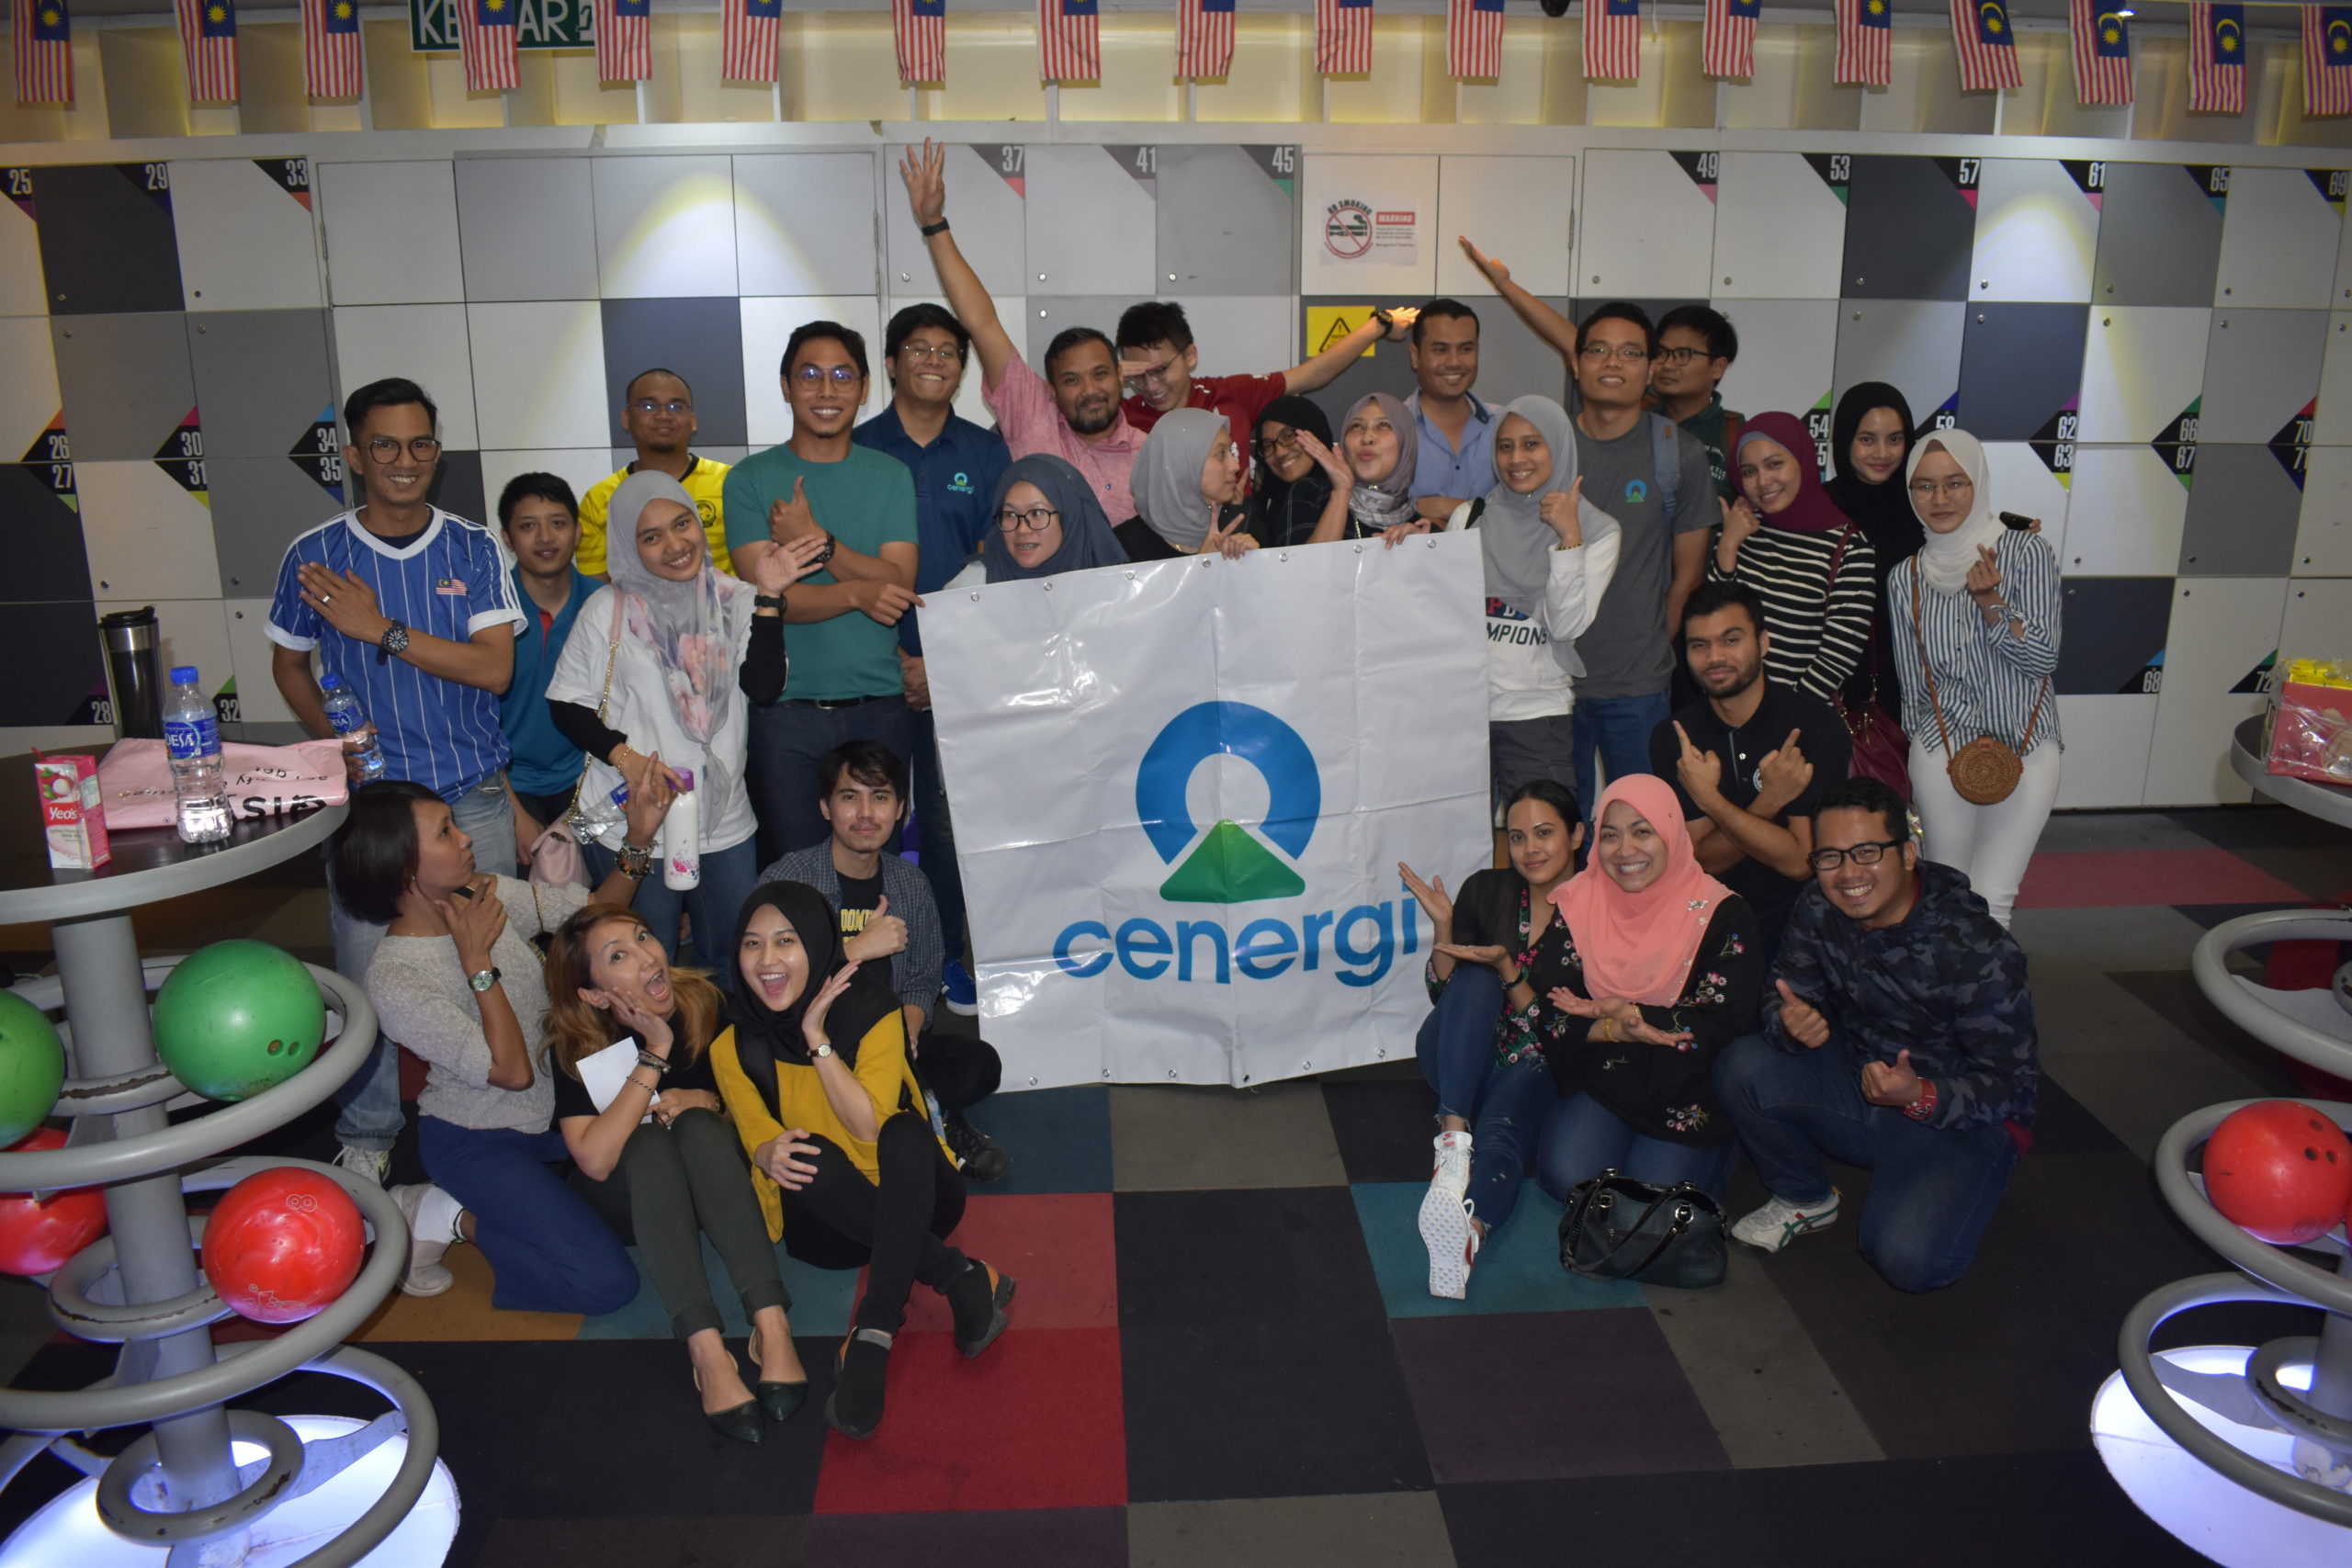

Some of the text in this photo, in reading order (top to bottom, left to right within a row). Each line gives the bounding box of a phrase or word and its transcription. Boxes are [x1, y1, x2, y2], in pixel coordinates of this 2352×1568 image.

[418, 0, 571, 45] KEAR
[1002, 146, 1024, 173] 37
[1136, 147, 1157, 173] 41
[1272, 147, 1294, 173] 45
[1697, 152, 1719, 178] 49
[1830, 154, 1851, 180] 53
[1959, 158, 1980, 184] 57
[9, 169, 32, 195] 25
[145, 164, 168, 190] 29
[286, 160, 309, 186] 33
[2088, 162, 2106, 187] 61
[2210, 167, 2231, 192] 65
[2329, 171, 2349, 196] 69
[1327, 199, 1373, 216] NO SMOKING
[1809, 413, 1829, 439] 54
[2058, 416, 2076, 440] 62
[2179, 418, 2199, 442] 66
[2294, 420, 2312, 444] 70
[49, 434, 70, 460] 26
[181, 432, 203, 457] 30
[317, 427, 338, 453] 34
[2053, 444, 2074, 468] 63
[2177, 446, 2196, 469] 67
[2293, 446, 2309, 469] 71
[52, 464, 73, 489] 27
[188, 461, 208, 485] 31
[320, 457, 342, 481] 35
[2143, 671, 2162, 693] 68
[2256, 671, 2272, 693] 72
[92, 701, 112, 724] 28
[220, 699, 241, 723] 32
[165, 732, 195, 749] DESA
[49, 807, 79, 820] Yeo's
[1053, 879, 1418, 987] cenergi
